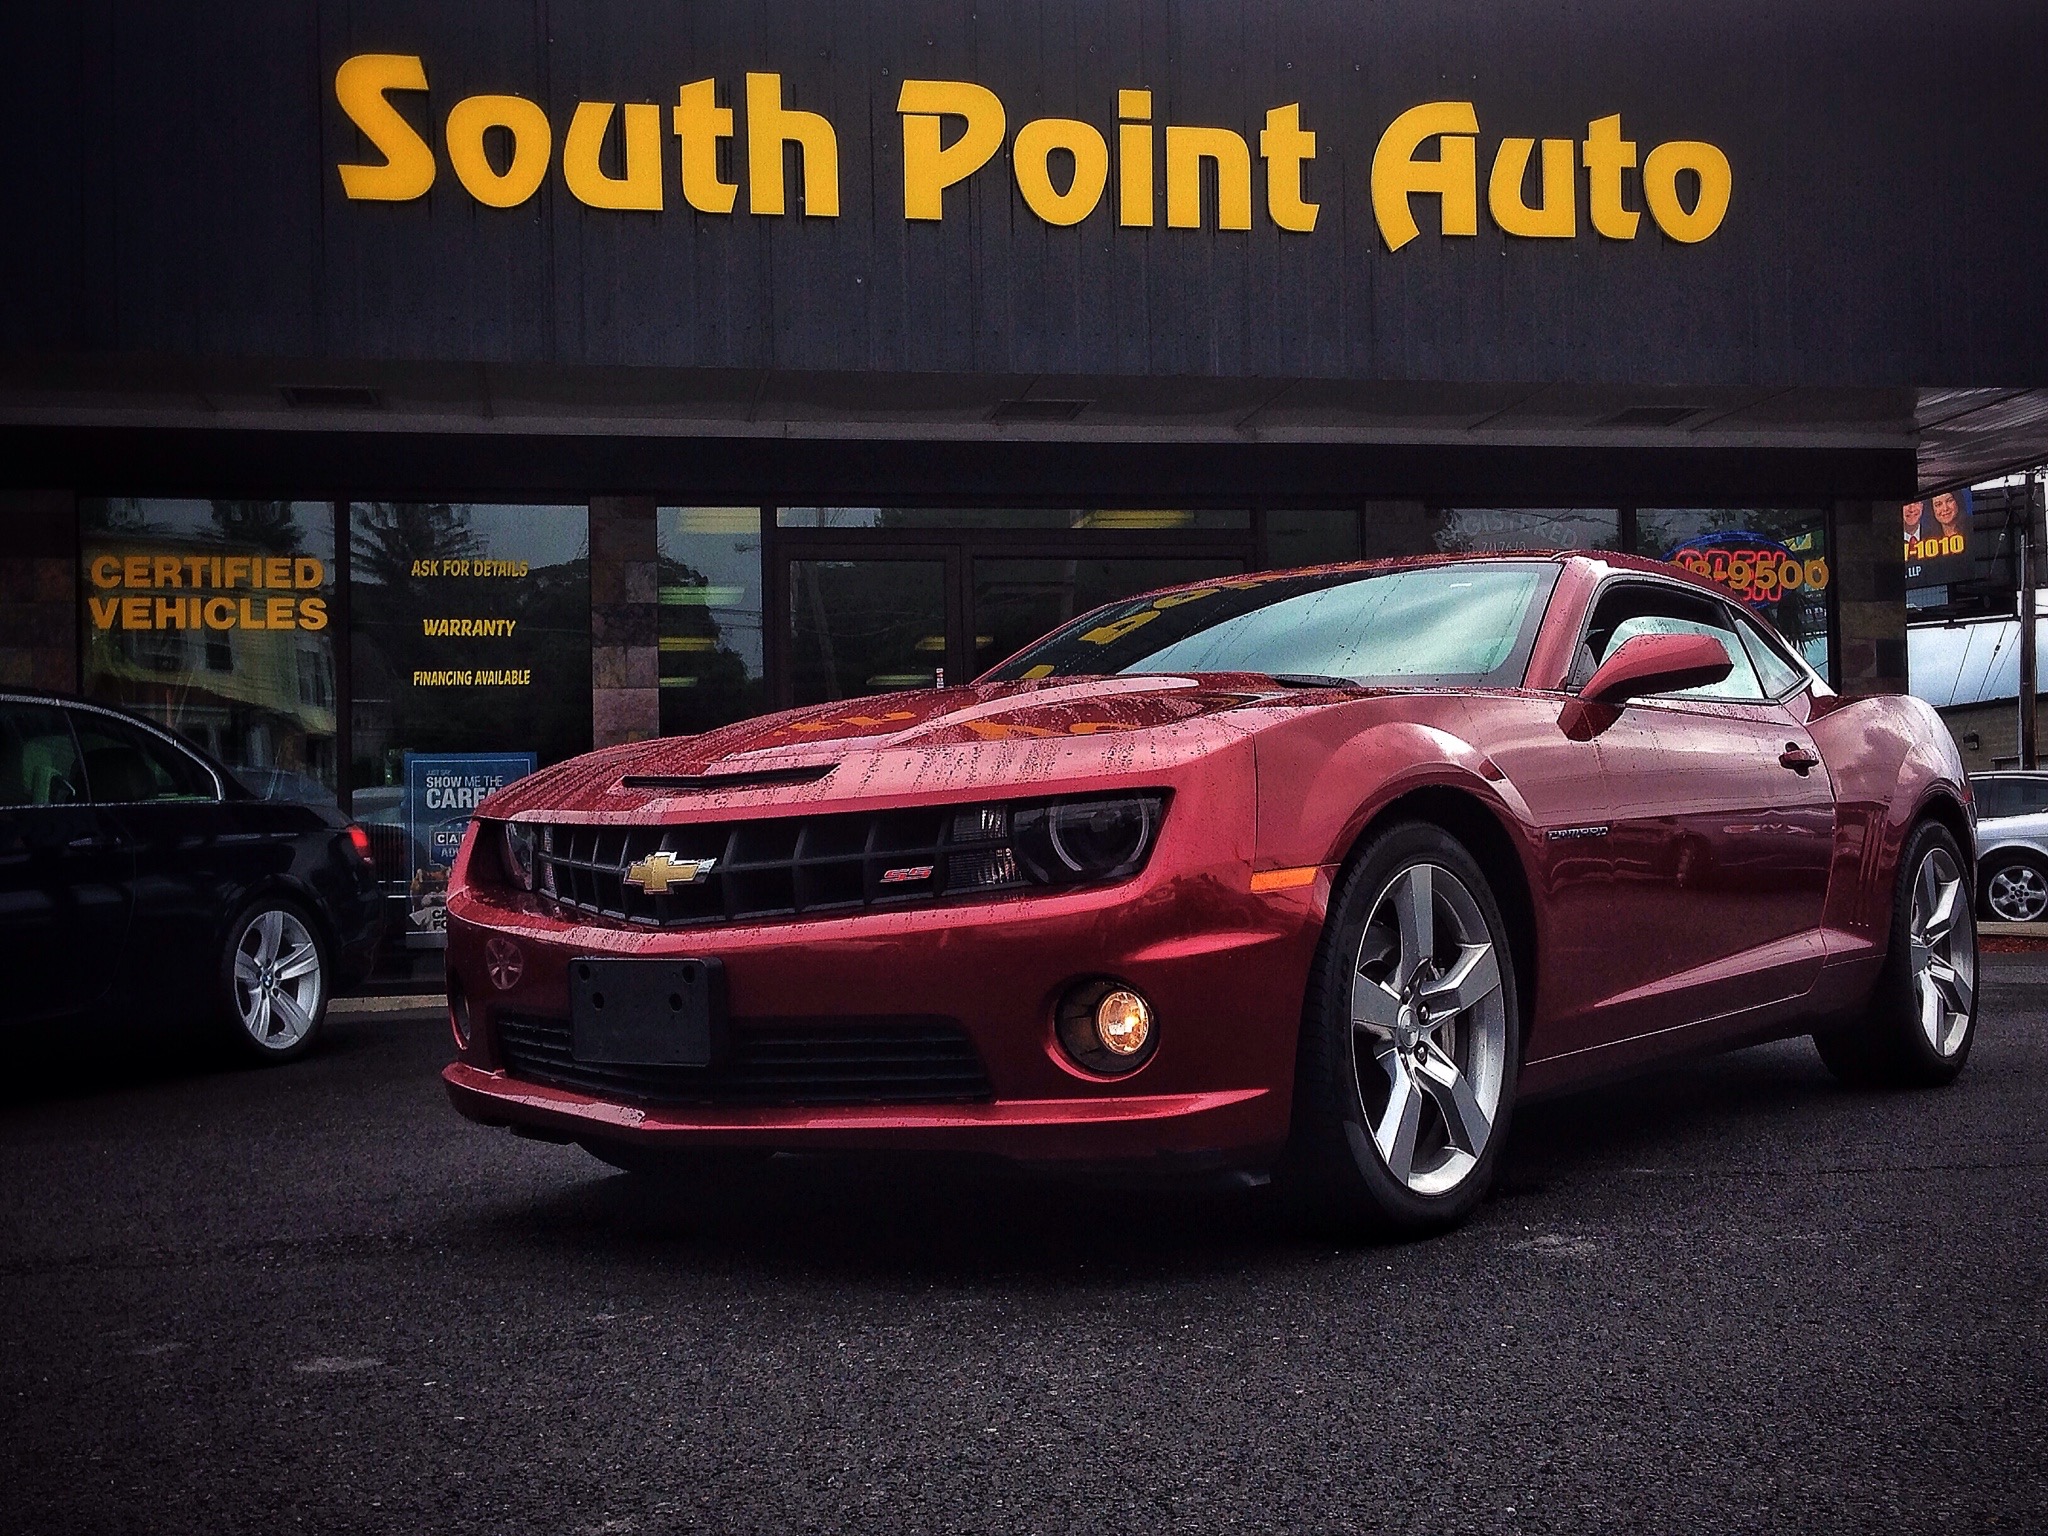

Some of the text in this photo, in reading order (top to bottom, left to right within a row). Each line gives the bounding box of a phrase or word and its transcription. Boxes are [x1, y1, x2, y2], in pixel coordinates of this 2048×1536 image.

[334, 54, 1732, 252] South Point Auto
[91, 556, 324, 589] CERTIFIED
[411, 559, 529, 577] ASK FOR DETAILS
[1670, 560, 1829, 589] 8-9500
[1908, 566, 1922, 577] LLP
[88, 597, 328, 630] VEHICLES
[423, 619, 516, 637] WARRANTY
[413, 669, 531, 686] FINANCING AVAILABLE
[427, 775, 503, 788] SHOW ME THE
[427, 787, 502, 809] CARF
[880, 866, 934, 883] SS
